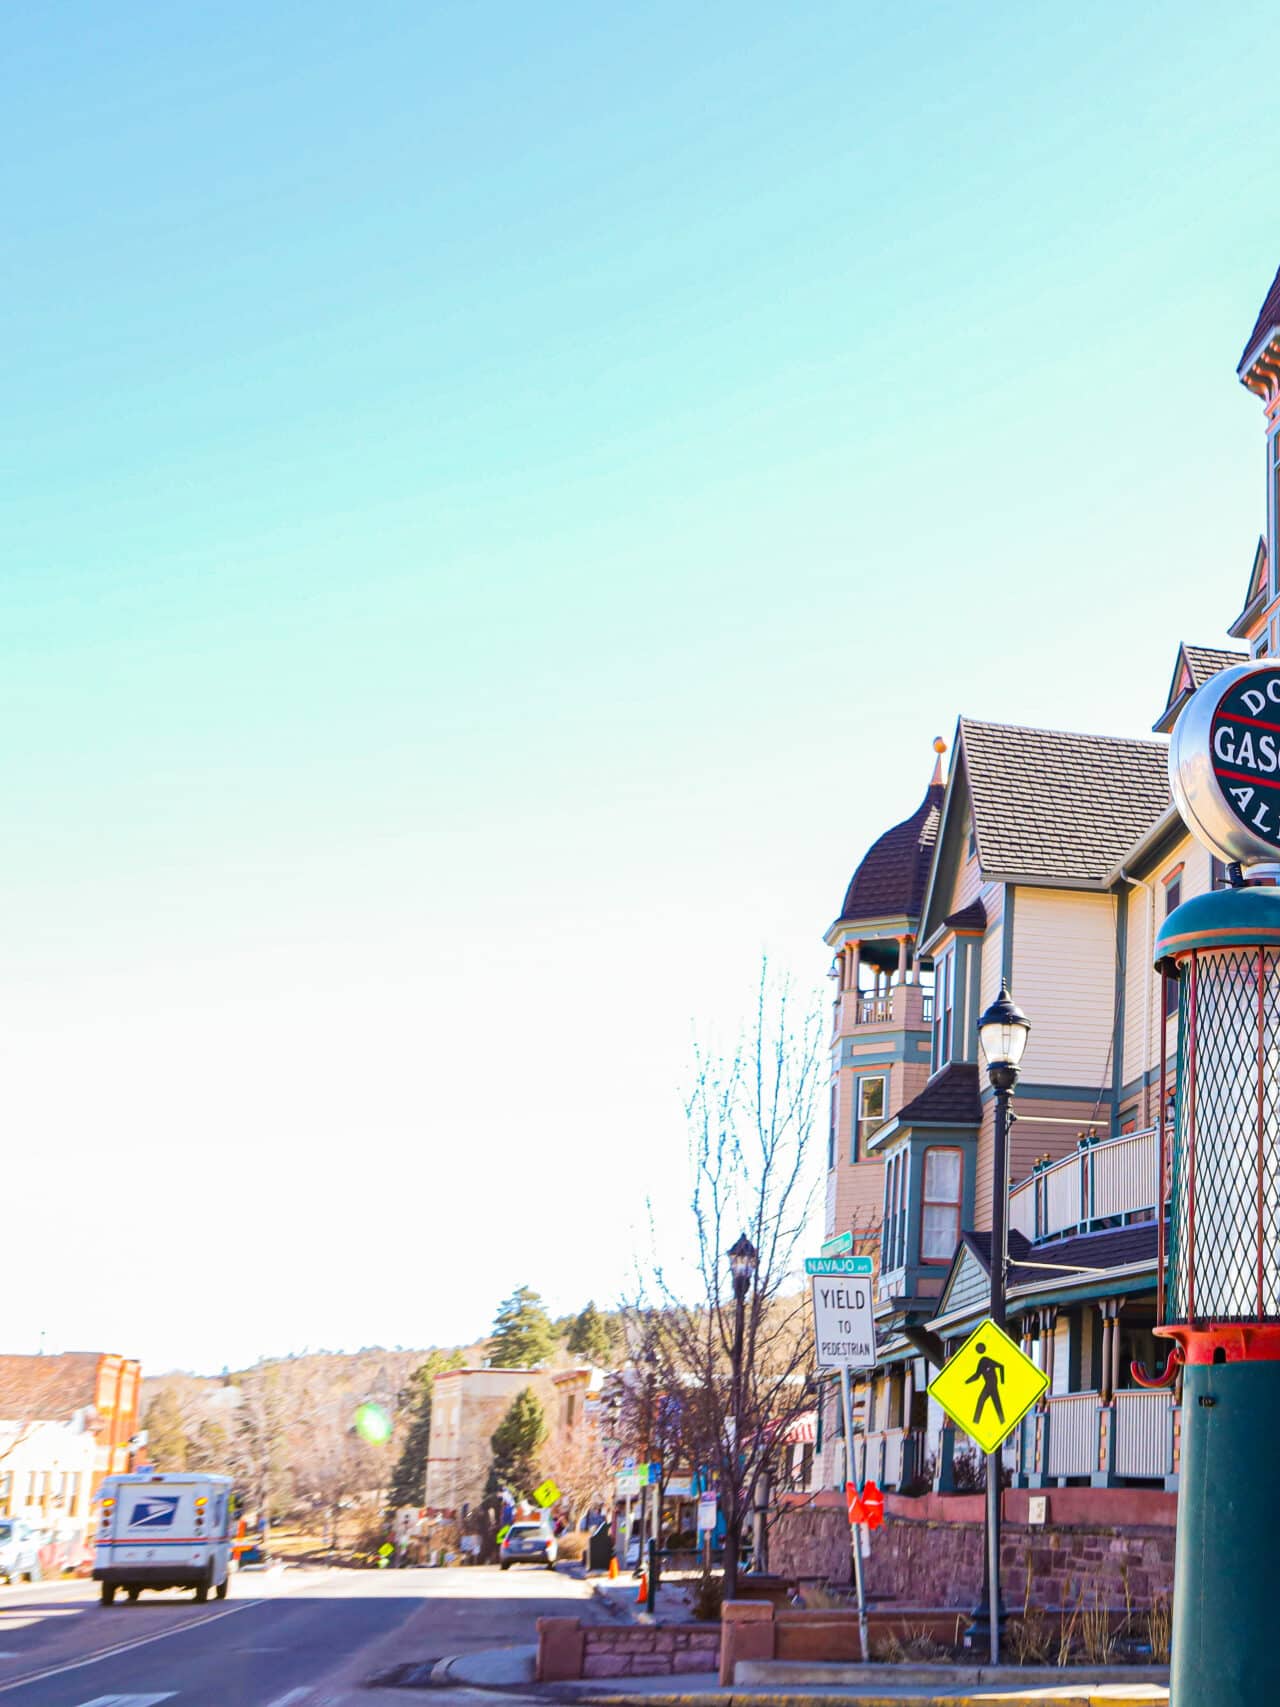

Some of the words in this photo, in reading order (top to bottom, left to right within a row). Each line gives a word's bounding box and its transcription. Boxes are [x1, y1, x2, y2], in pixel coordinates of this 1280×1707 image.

[808, 1259, 854, 1272] NAVAJO
[820, 1289, 865, 1310] YIELD
[838, 1320, 851, 1334] TO
[822, 1342, 870, 1356] PEDESTRIAN
